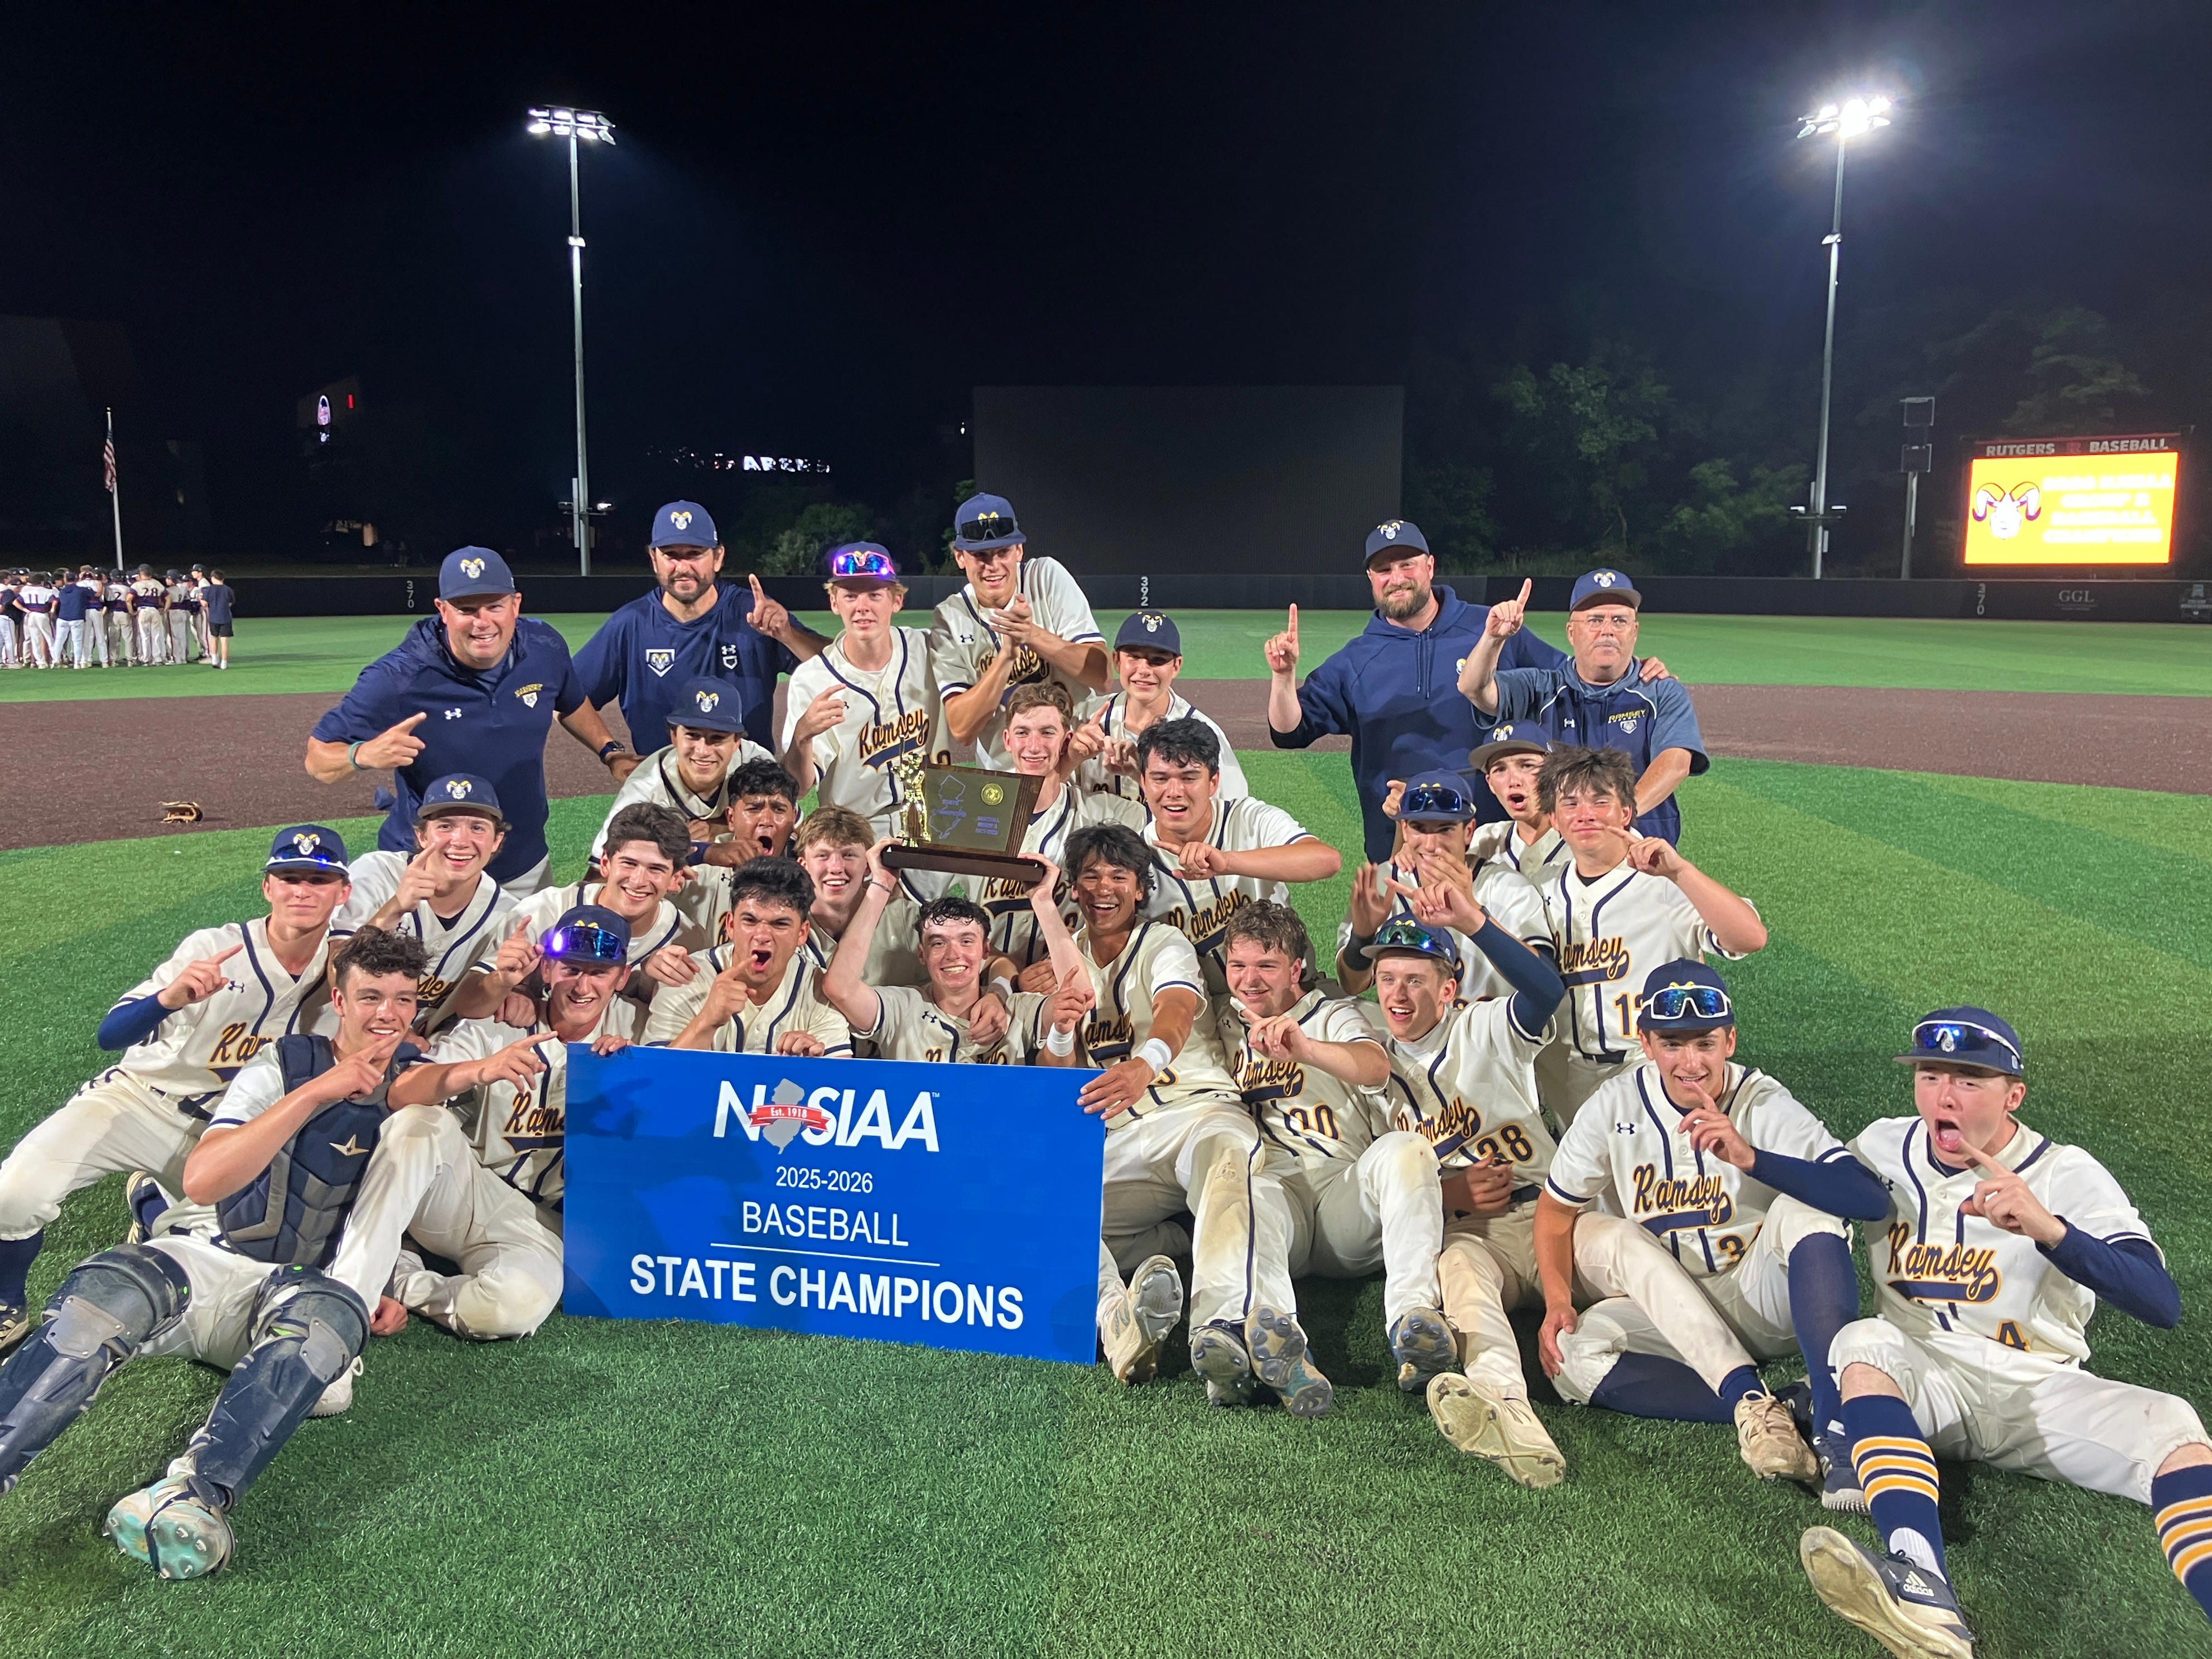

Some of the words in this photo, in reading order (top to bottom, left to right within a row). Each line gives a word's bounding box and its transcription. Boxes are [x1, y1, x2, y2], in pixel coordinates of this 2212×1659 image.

[1986, 443, 2055, 456] RUTGERS
[2089, 438, 2168, 452] BASEBALL
[406, 580, 415, 609] 370
[1140, 576, 1149, 606] 392
[2059, 590, 2094, 602] GGL
[859, 708, 931, 760] Ramsey
[770, 1107, 785, 1116] Est.
[787, 1107, 807, 1118] 1918
[775, 1166, 873, 1193] 2025-2026
[1633, 1163, 1733, 1225] Ramsey
[743, 1201, 909, 1247] BASEBALL
[1887, 1221, 2001, 1303] Ramsey
[630, 1253, 756, 1303] STATE
[770, 1265, 1024, 1330] CHAMPIONS
